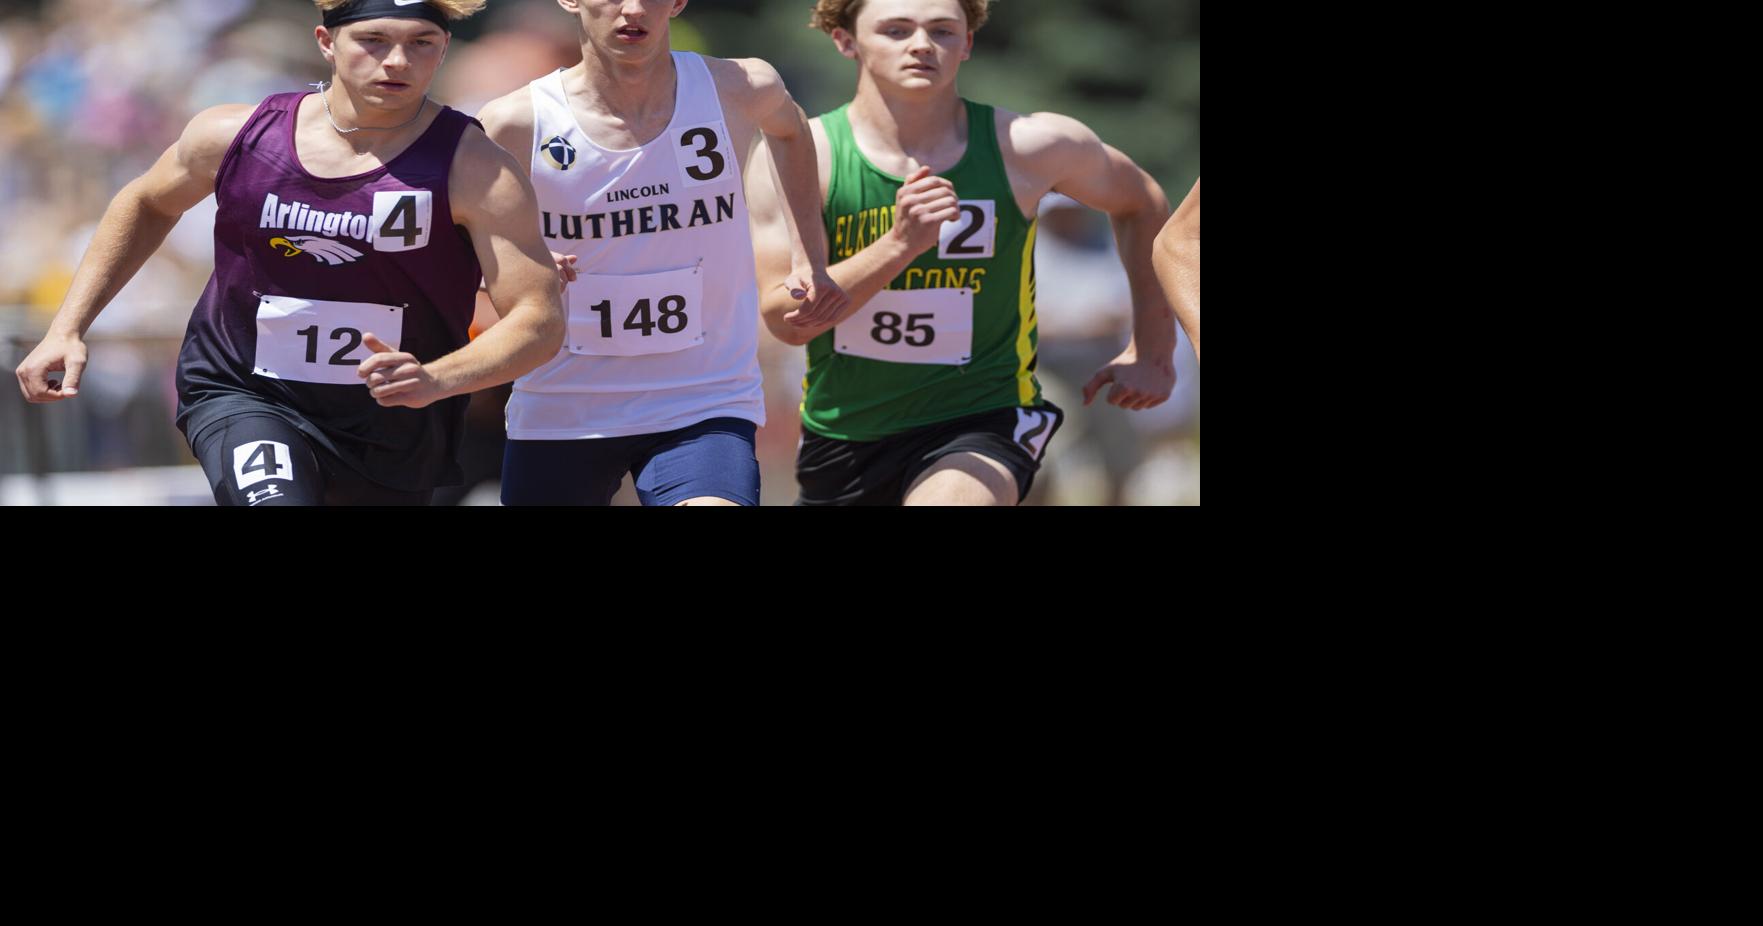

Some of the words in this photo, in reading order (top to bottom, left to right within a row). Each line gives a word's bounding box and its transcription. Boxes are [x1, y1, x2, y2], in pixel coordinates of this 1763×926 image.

[680, 127, 725, 181] 3
[541, 192, 735, 239] LUTHERAN
[606, 183, 670, 203] LINCOLN
[380, 195, 422, 247] 4
[836, 204, 897, 257] ELKHO
[945, 204, 985, 254] 2
[884, 267, 987, 294] CONS
[590, 295, 689, 338] 148
[870, 311, 936, 347] 85
[296, 324, 363, 366] 12
[1019, 408, 1048, 456] 2
[241, 443, 284, 477] 4
